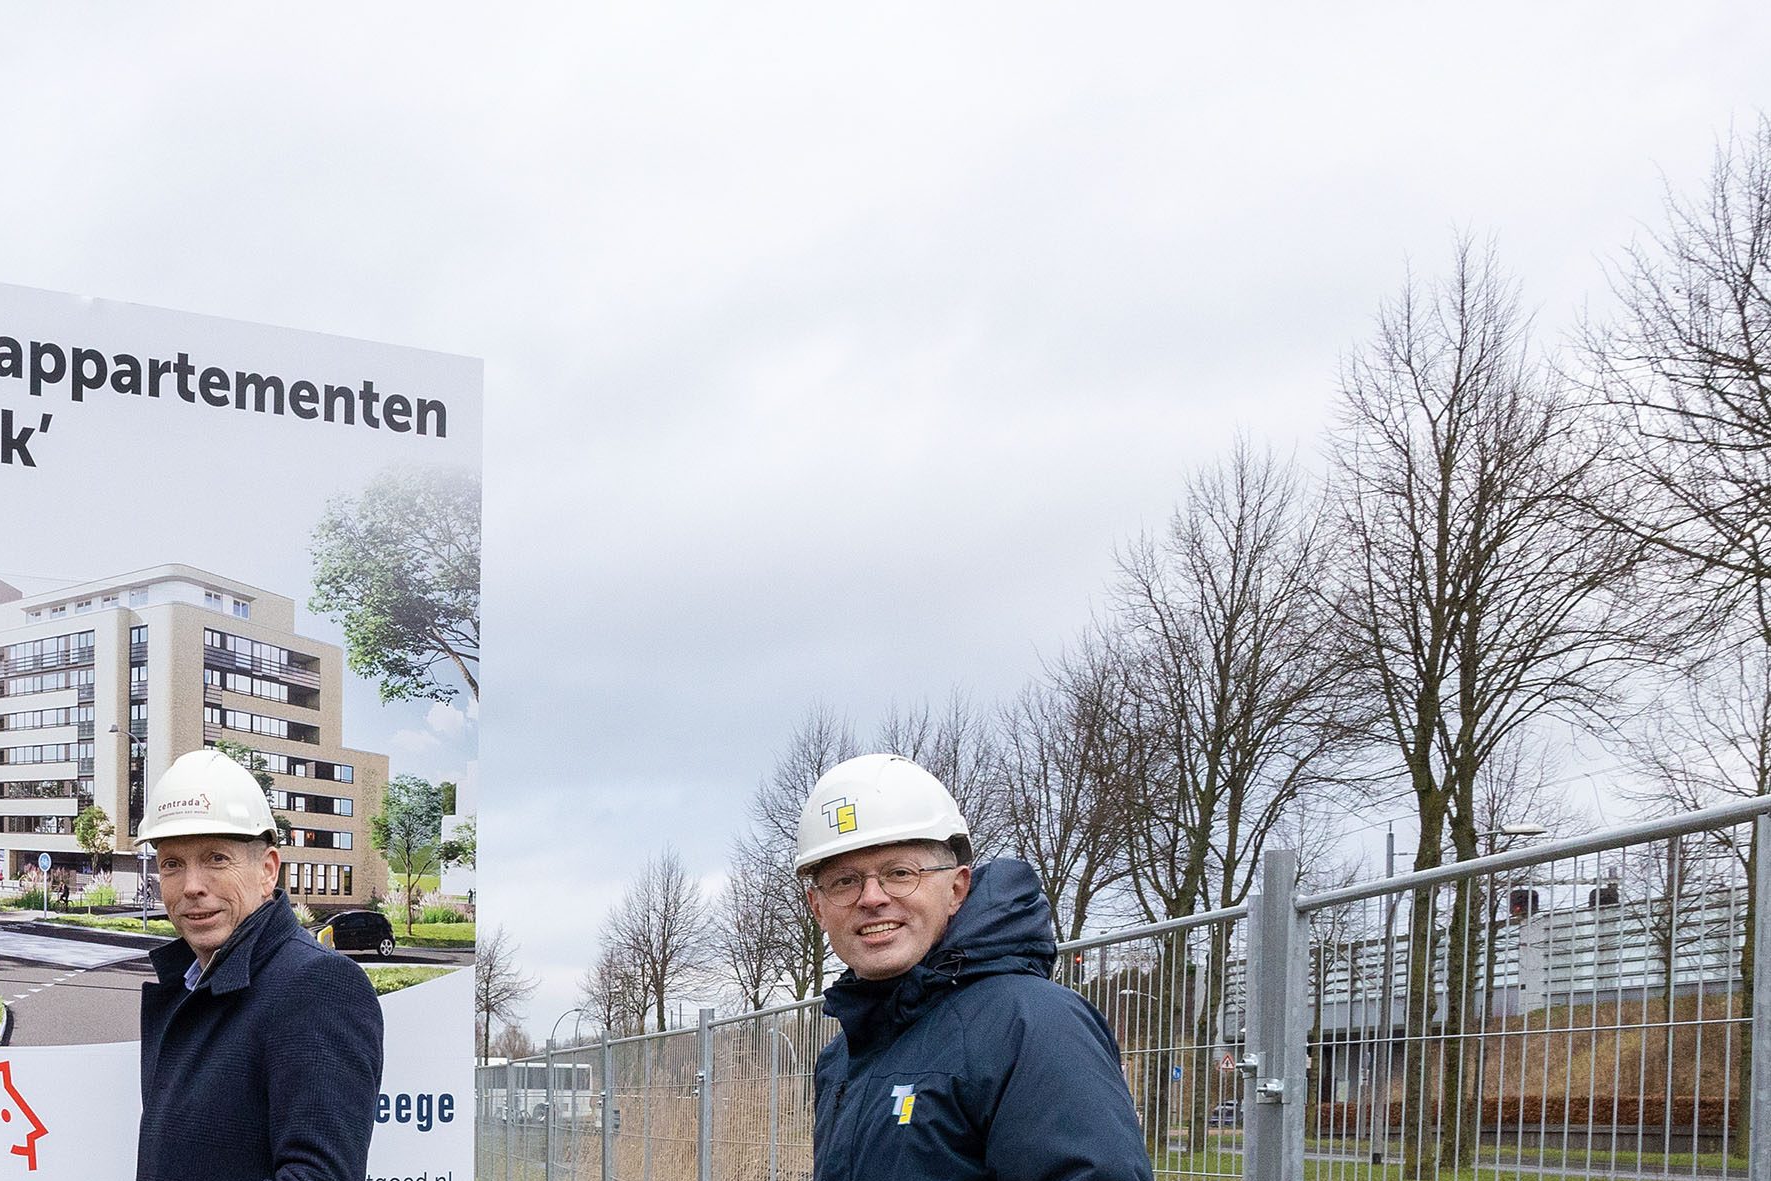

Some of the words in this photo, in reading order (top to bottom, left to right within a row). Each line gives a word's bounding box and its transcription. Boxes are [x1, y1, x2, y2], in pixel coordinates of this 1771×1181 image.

[157, 798, 200, 812] centrada
[821, 796, 858, 835] TS
[890, 1084, 917, 1126] TS
